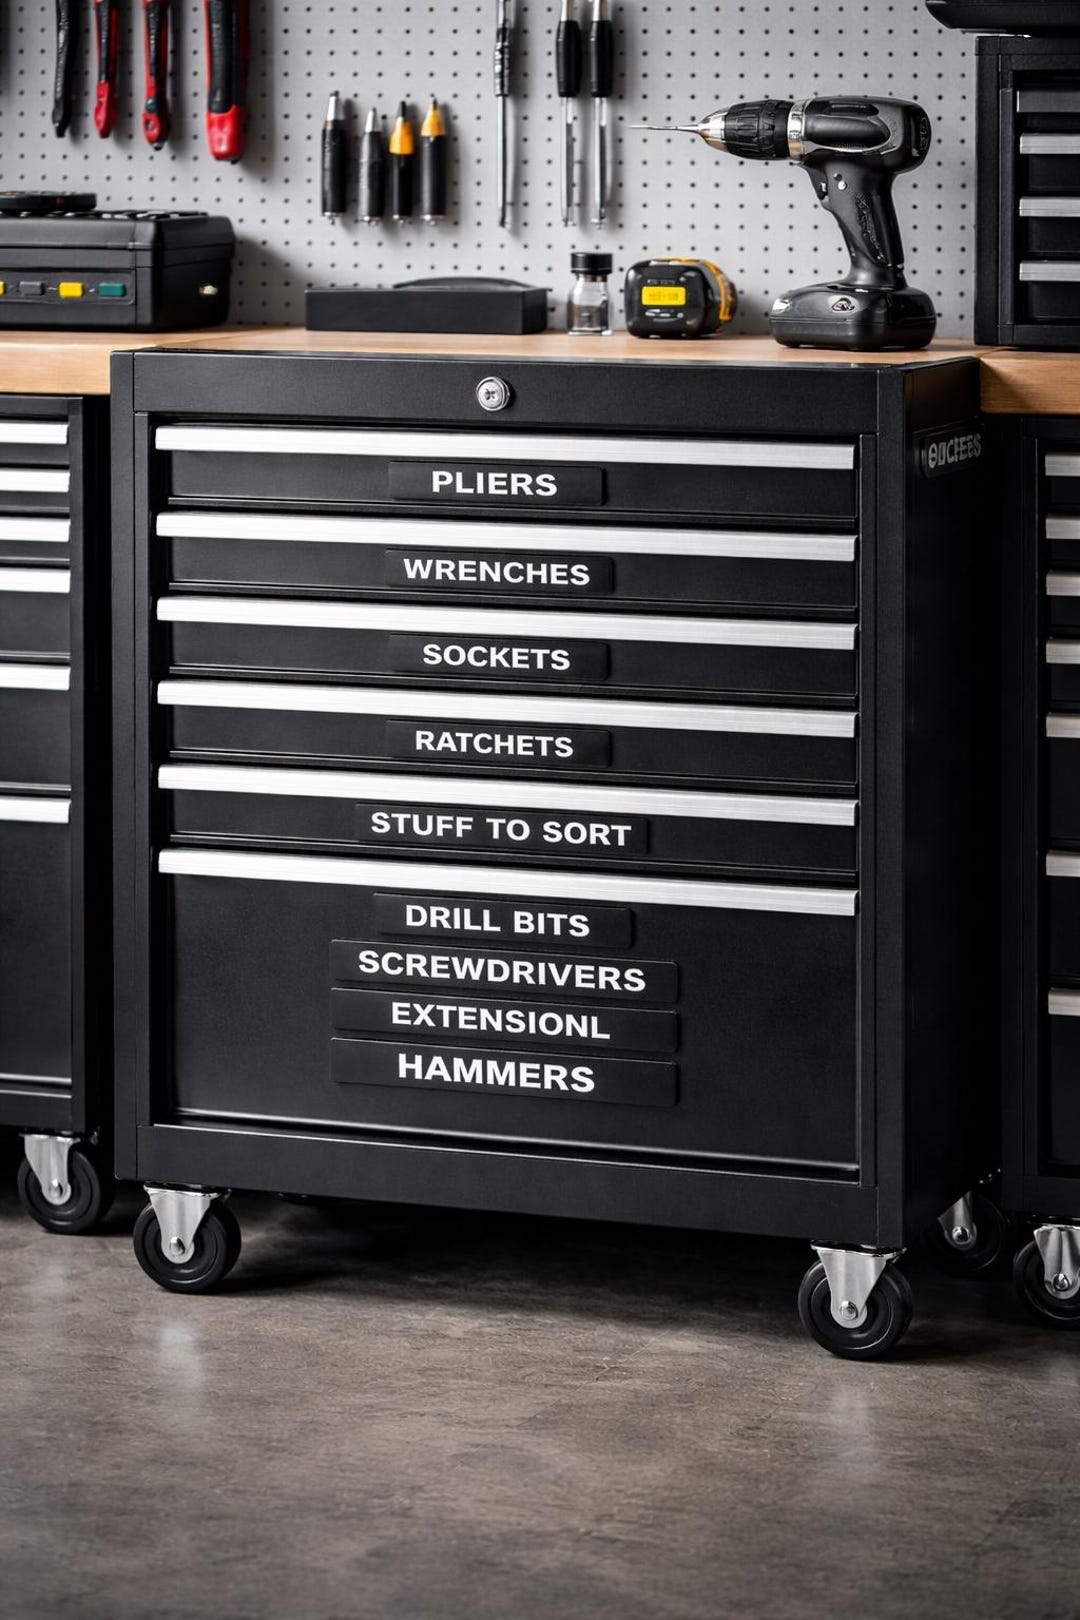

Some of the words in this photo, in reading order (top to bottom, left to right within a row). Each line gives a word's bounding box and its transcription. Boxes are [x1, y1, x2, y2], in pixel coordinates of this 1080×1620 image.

[432, 471, 557, 496] PLIERS
[403, 558, 590, 586] WRENCHES
[423, 644, 570, 671] SOCKETS
[415, 730, 573, 758] RATCHETS
[371, 812, 473, 837] STUFF
[486, 818, 530, 841] TO
[543, 821, 632, 846] SORT
[405, 905, 501, 932] DRILL
[514, 911, 590, 937] BITS
[358, 950, 646, 993] SCREWDRIVERS
[392, 1001, 610, 1040] EXTENSIONL
[398, 1053, 595, 1092] HAMMERS
